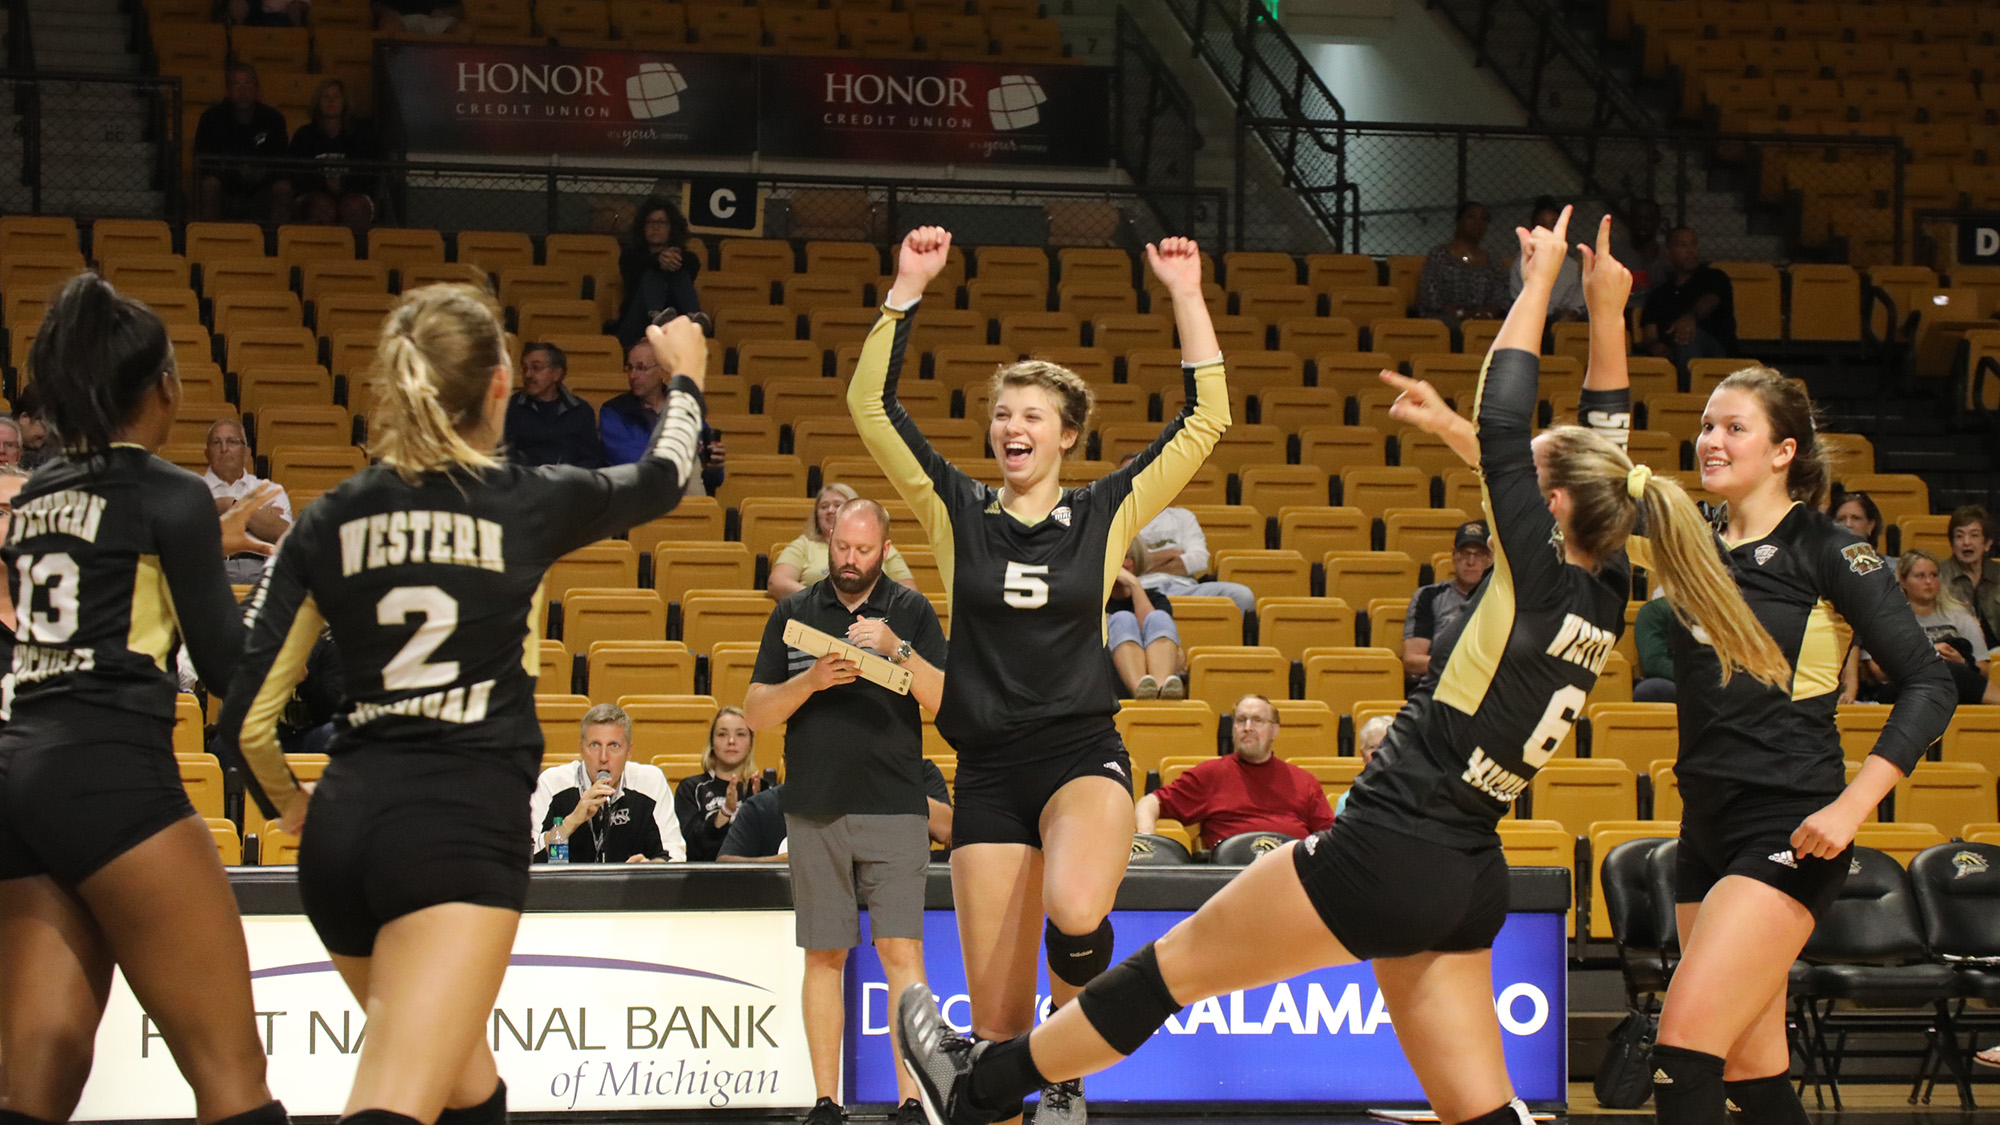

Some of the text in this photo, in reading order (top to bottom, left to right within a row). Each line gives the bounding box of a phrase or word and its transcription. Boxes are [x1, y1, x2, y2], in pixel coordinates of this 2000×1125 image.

[456, 62, 611, 97] HONOR
[825, 73, 974, 108] HONOR
[456, 103, 611, 118] CREDIT UNION
[823, 113, 972, 129] CREDIT UNION
[622, 128, 659, 147] your
[709, 188, 737, 219] C
[1976, 228, 2000, 256] D
[339, 510, 505, 578] WESTERN
[15, 552, 81, 644] 13
[1003, 560, 1050, 610] 5
[376, 585, 461, 691] 2
[1522, 684, 1587, 770] 6
[626, 1004, 780, 1051] BANK
[550, 1059, 780, 1111] of Michigan
